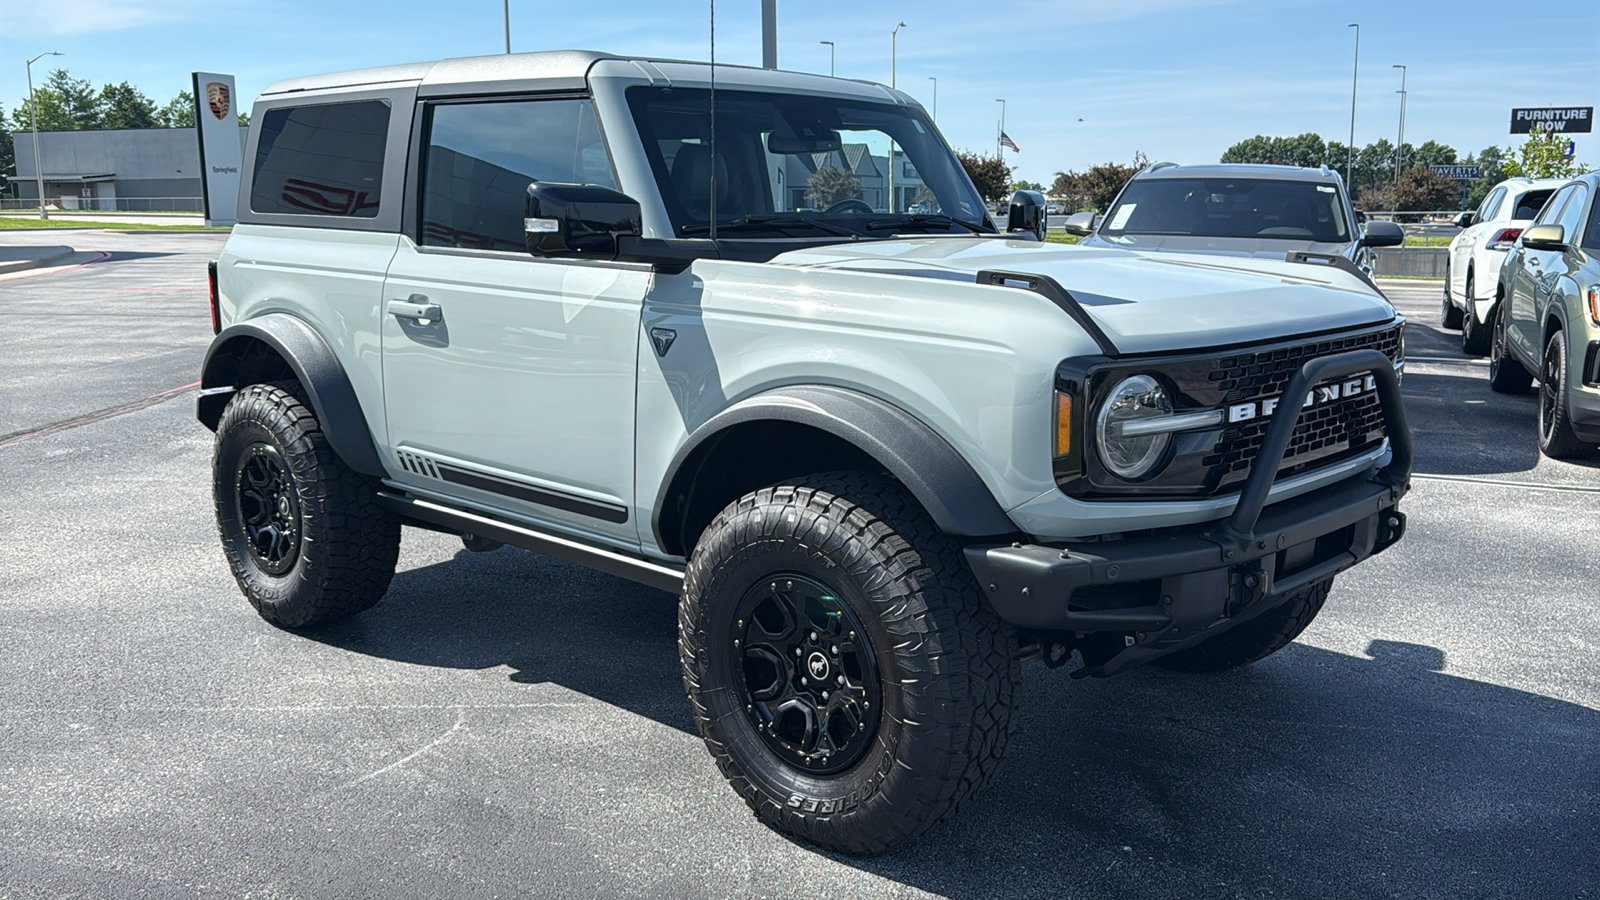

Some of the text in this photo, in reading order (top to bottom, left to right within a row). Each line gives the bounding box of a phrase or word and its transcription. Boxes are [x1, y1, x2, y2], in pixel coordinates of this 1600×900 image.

[1516, 109, 1588, 121] FURNITURE
[1536, 121, 1566, 131] ROW
[212, 166, 237, 174] Springfield
[785, 791, 859, 815] TIRES
